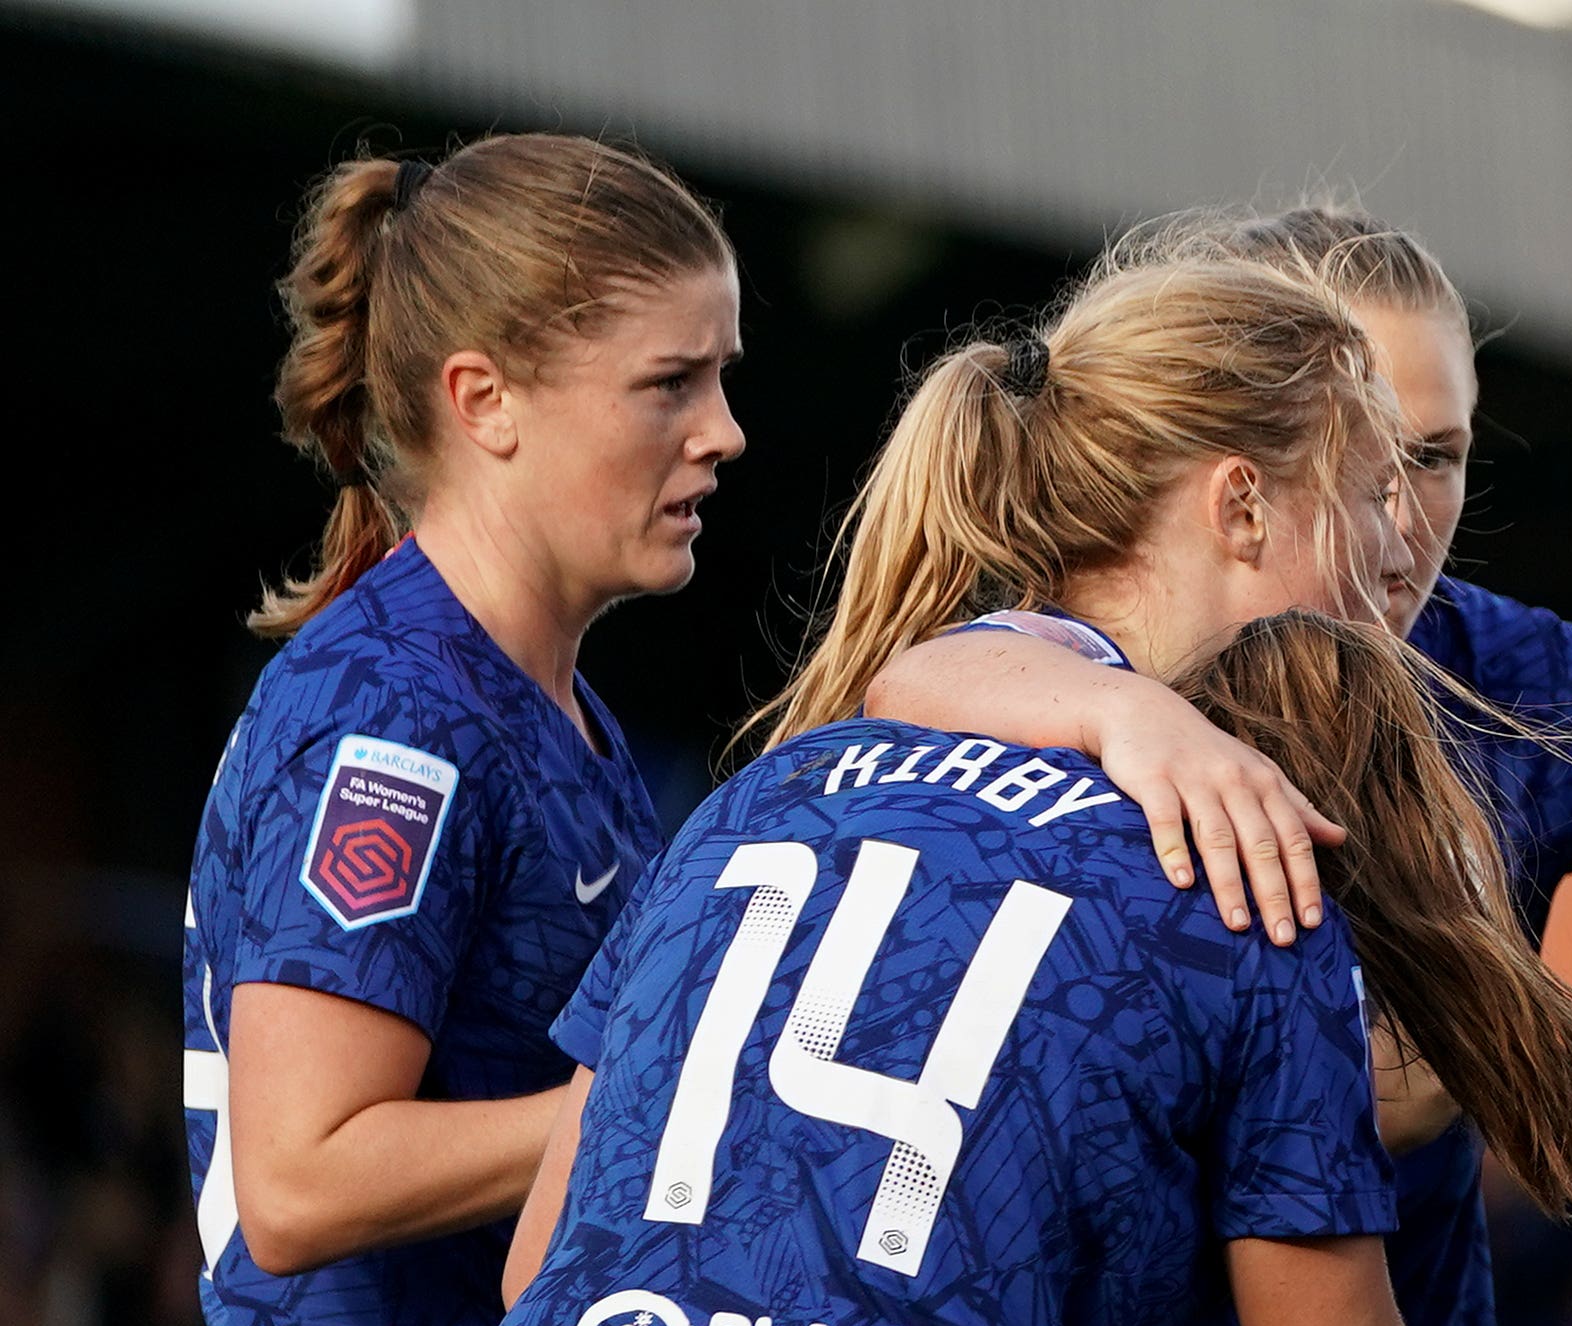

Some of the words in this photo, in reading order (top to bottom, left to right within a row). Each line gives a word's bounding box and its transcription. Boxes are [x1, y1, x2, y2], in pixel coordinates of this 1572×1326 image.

[370, 748, 442, 783] BARCLAYS
[823, 738, 1127, 826] KIRBY
[339, 787, 381, 808] Super
[381, 797, 429, 825] League
[350, 776, 367, 792] FA
[368, 780, 427, 810] Women's
[643, 840, 1073, 1277] 14
